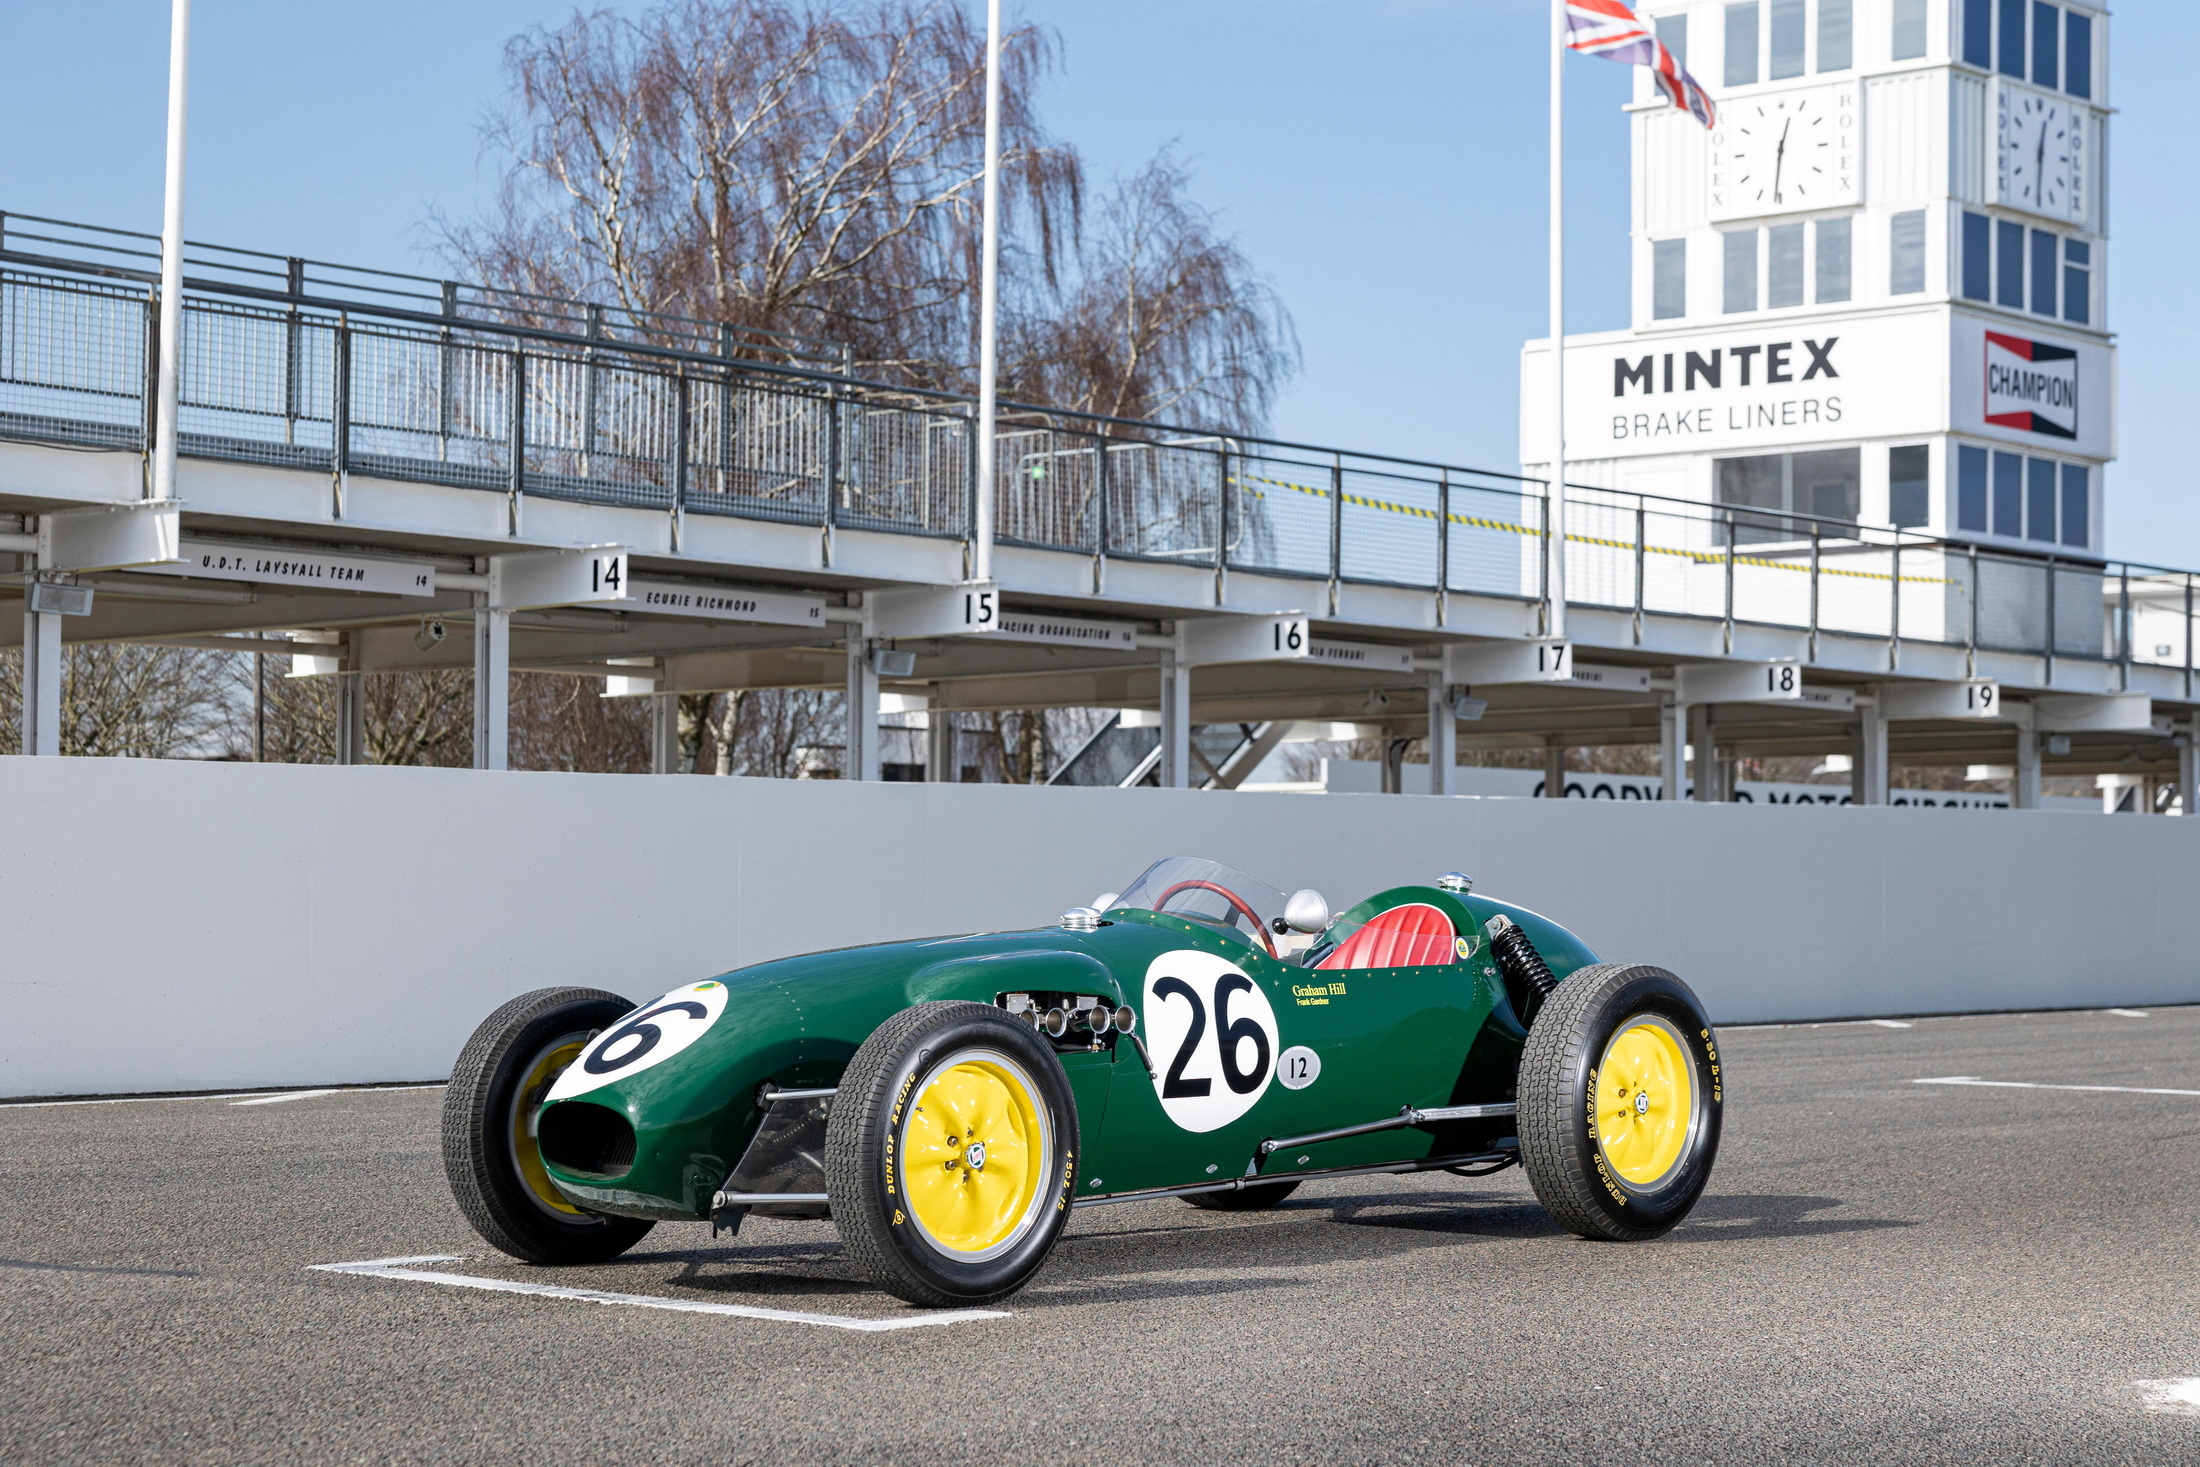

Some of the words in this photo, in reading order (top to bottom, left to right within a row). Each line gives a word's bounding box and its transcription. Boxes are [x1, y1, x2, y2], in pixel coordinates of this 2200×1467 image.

[1839, 94, 1853, 191] ROLEX
[2072, 114, 2082, 212] ROLEX
[1614, 336, 1841, 398] MINTEX
[1989, 363, 2075, 410] CHAMPION
[1613, 408, 1713, 440] BRAKE
[1729, 396, 1842, 431] LINERS
[202, 554, 247, 572] U.D.T.
[255, 559, 323, 578] LAYSYALL
[329, 565, 366, 582] TEAM
[415, 574, 428, 588] 14
[592, 556, 622, 594] 14
[646, 591, 691, 608] ECURIE
[695, 596, 757, 613] RICHMOND
[809, 606, 820, 619] 15
[965, 593, 993, 625] 15
[1039, 623, 1111, 640] ORGANISATION
[1274, 622, 1302, 652] 16
[1538, 645, 1565, 673] 17
[1768, 666, 1794, 693] 18
[1967, 685, 1993, 710] 19
[1292, 984, 1329, 997] Graham
[1327, 982, 1347, 996] Hill
[1151, 972, 1271, 1100] 26
[1290, 1056, 1307, 1079] 12
[1586, 1068, 1598, 1139] RACING
[886, 1133, 896, 1195] DUNLOP
[891, 1072, 917, 1126] RACING
[1593, 1153, 1629, 1207] DUNLOP
